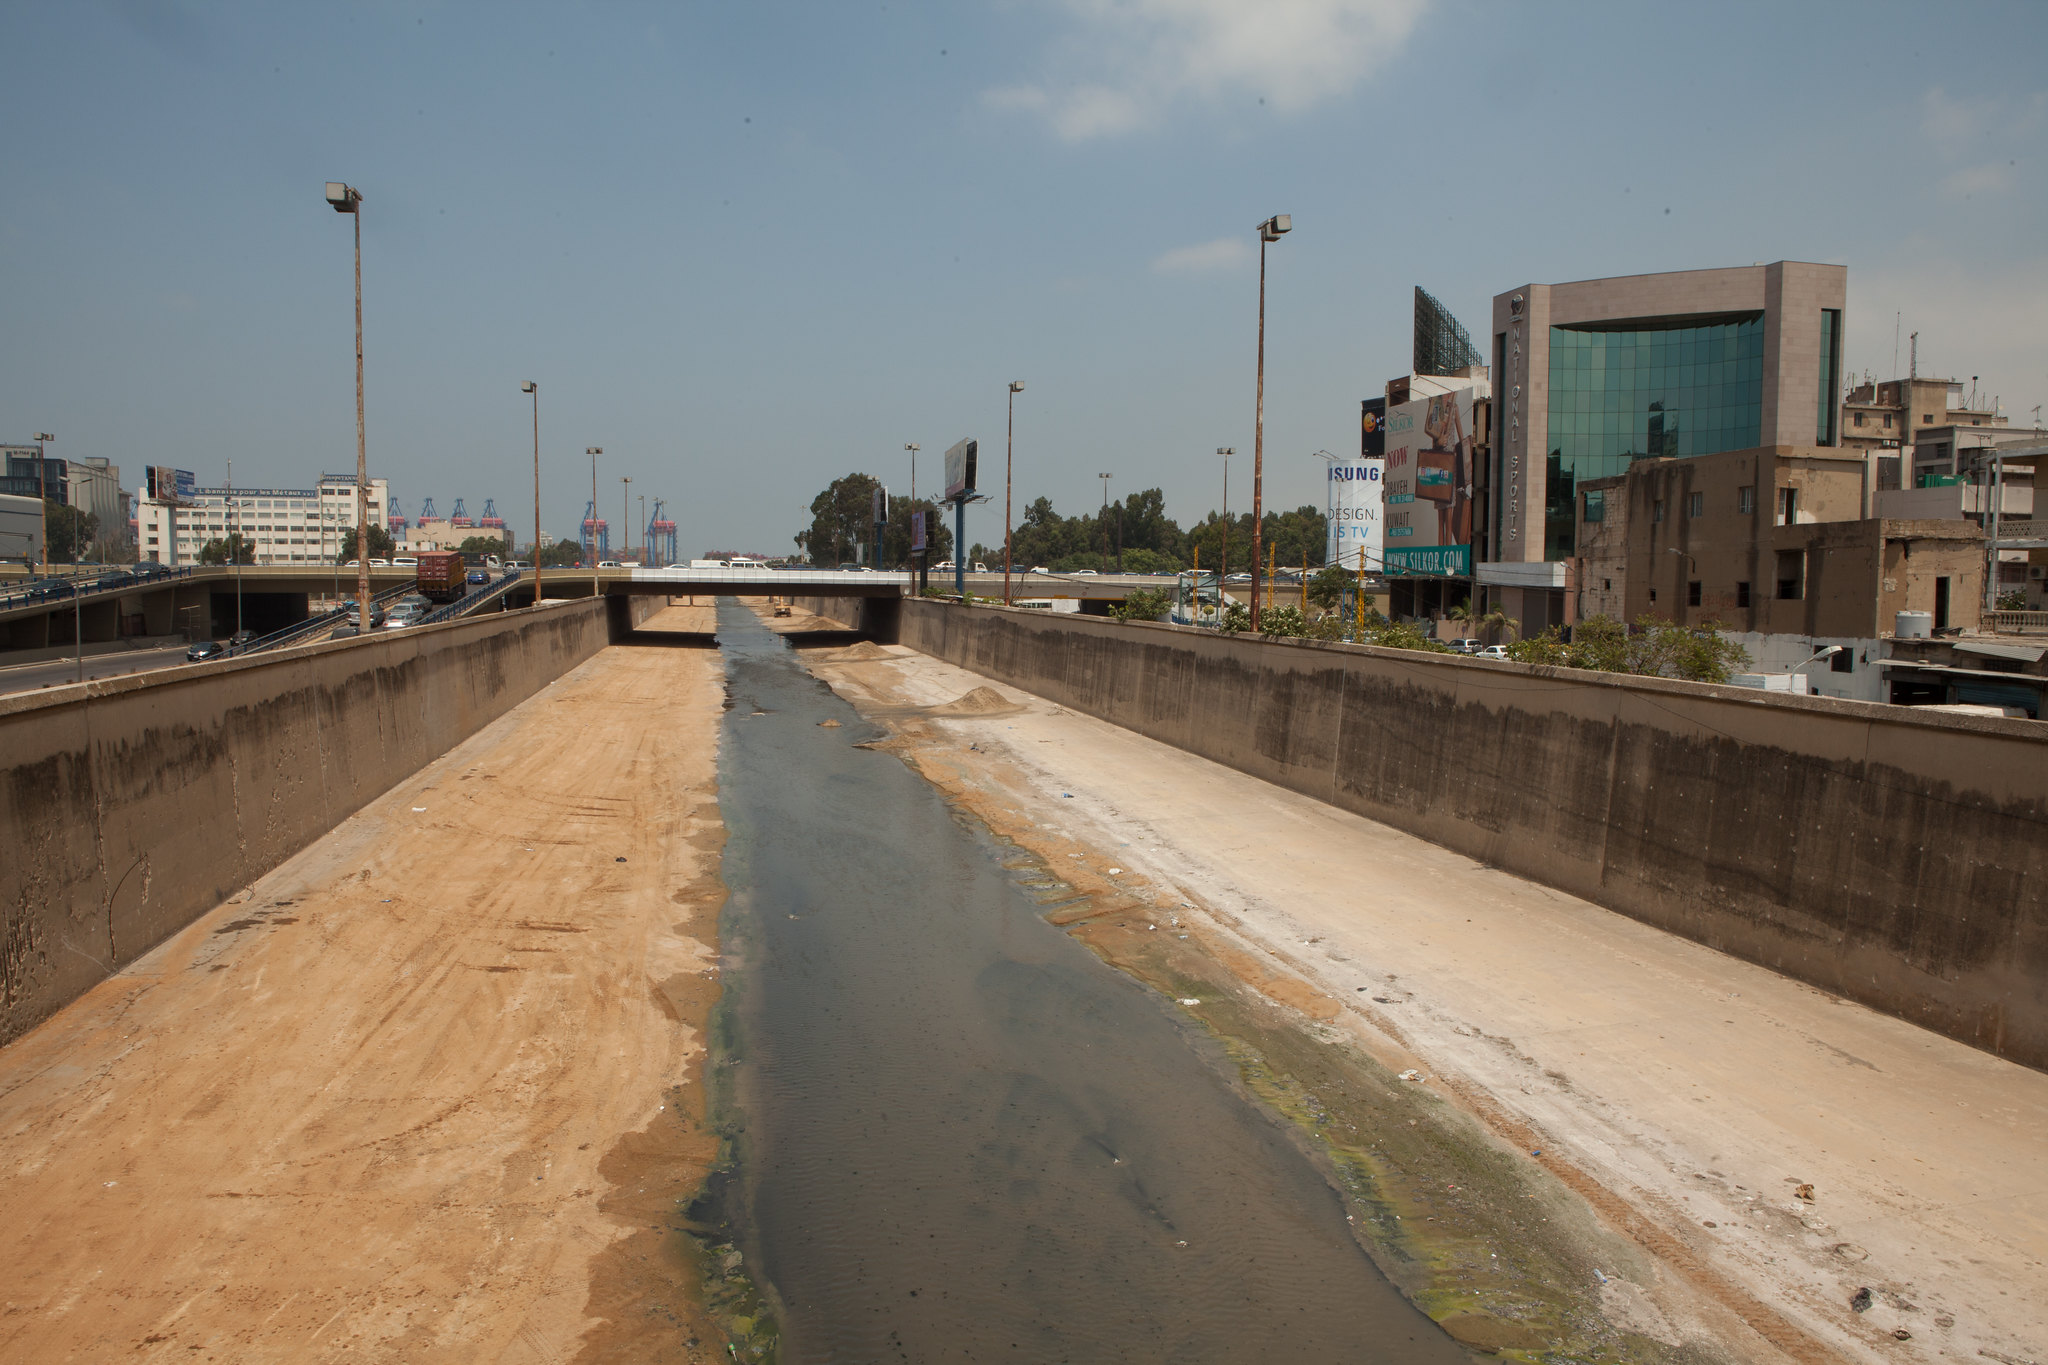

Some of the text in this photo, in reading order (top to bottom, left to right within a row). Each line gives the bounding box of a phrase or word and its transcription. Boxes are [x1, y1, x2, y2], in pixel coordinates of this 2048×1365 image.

[1511, 327, 1520, 443] NATIONAL
[1387, 415, 1415, 433] SILKOR
[1387, 445, 1409, 471] NOW
[239, 488, 258, 497] pour
[1386, 479, 1408, 497] DBAYEH
[1509, 455, 1518, 541] SPORTS
[1385, 511, 1410, 529] KUWAIT
[1333, 526, 1346, 538] IS
[1350, 526, 1369, 538] TV
[1386, 550, 1464, 573] WWWSILKOR.COM
